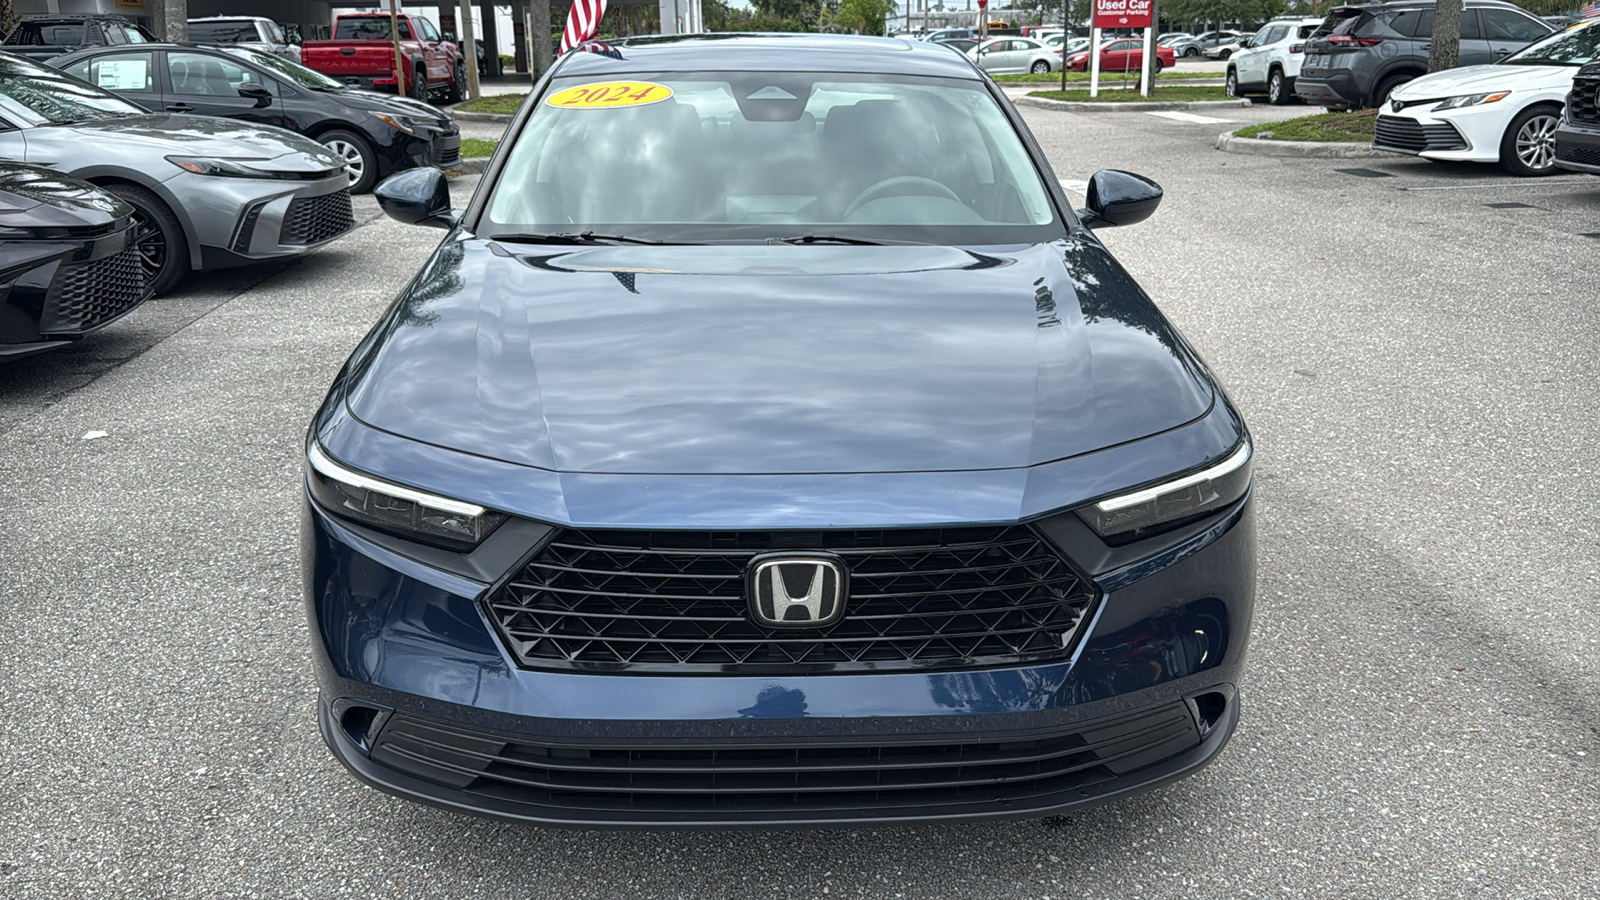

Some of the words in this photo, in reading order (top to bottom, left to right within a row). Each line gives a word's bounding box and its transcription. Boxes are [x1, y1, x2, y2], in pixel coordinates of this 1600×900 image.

[1097, 0, 1127, 9] Used
[1129, 0, 1150, 9] Car
[561, 86, 656, 105] 2024
